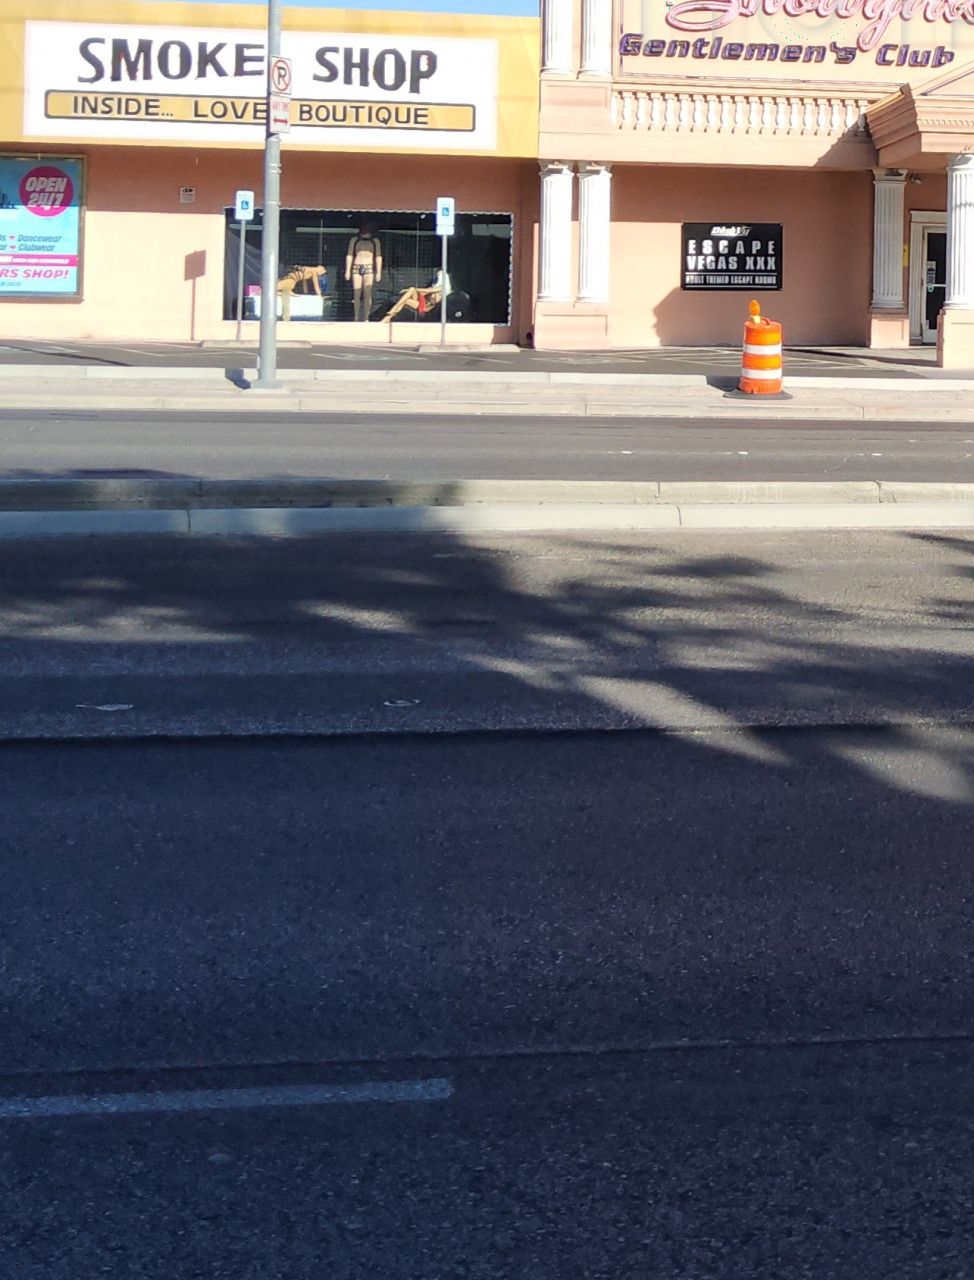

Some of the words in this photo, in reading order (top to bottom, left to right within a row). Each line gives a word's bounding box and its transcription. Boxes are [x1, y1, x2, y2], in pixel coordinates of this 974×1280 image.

[619, 33, 857, 64] Gentlemen's
[875, 43, 955, 69] Club
[78, 37, 265, 84] SMOKE
[312, 46, 438, 94] SHOP
[73, 96, 174, 116] INSIDE...
[194, 100, 267, 120] LOVE
[300, 104, 428, 125] BOUTIQUE
[25, 177, 68, 192] OPEN
[28, 193, 65, 210] 24/7
[17, 234, 62, 243] Dancewear
[18, 244, 56, 252] Clubwear
[688, 240, 776, 255] ESCAPE
[686, 255, 738, 270] VEGAS
[745, 256, 776, 270] XXX
[23, 269, 69, 279] SHOP!
